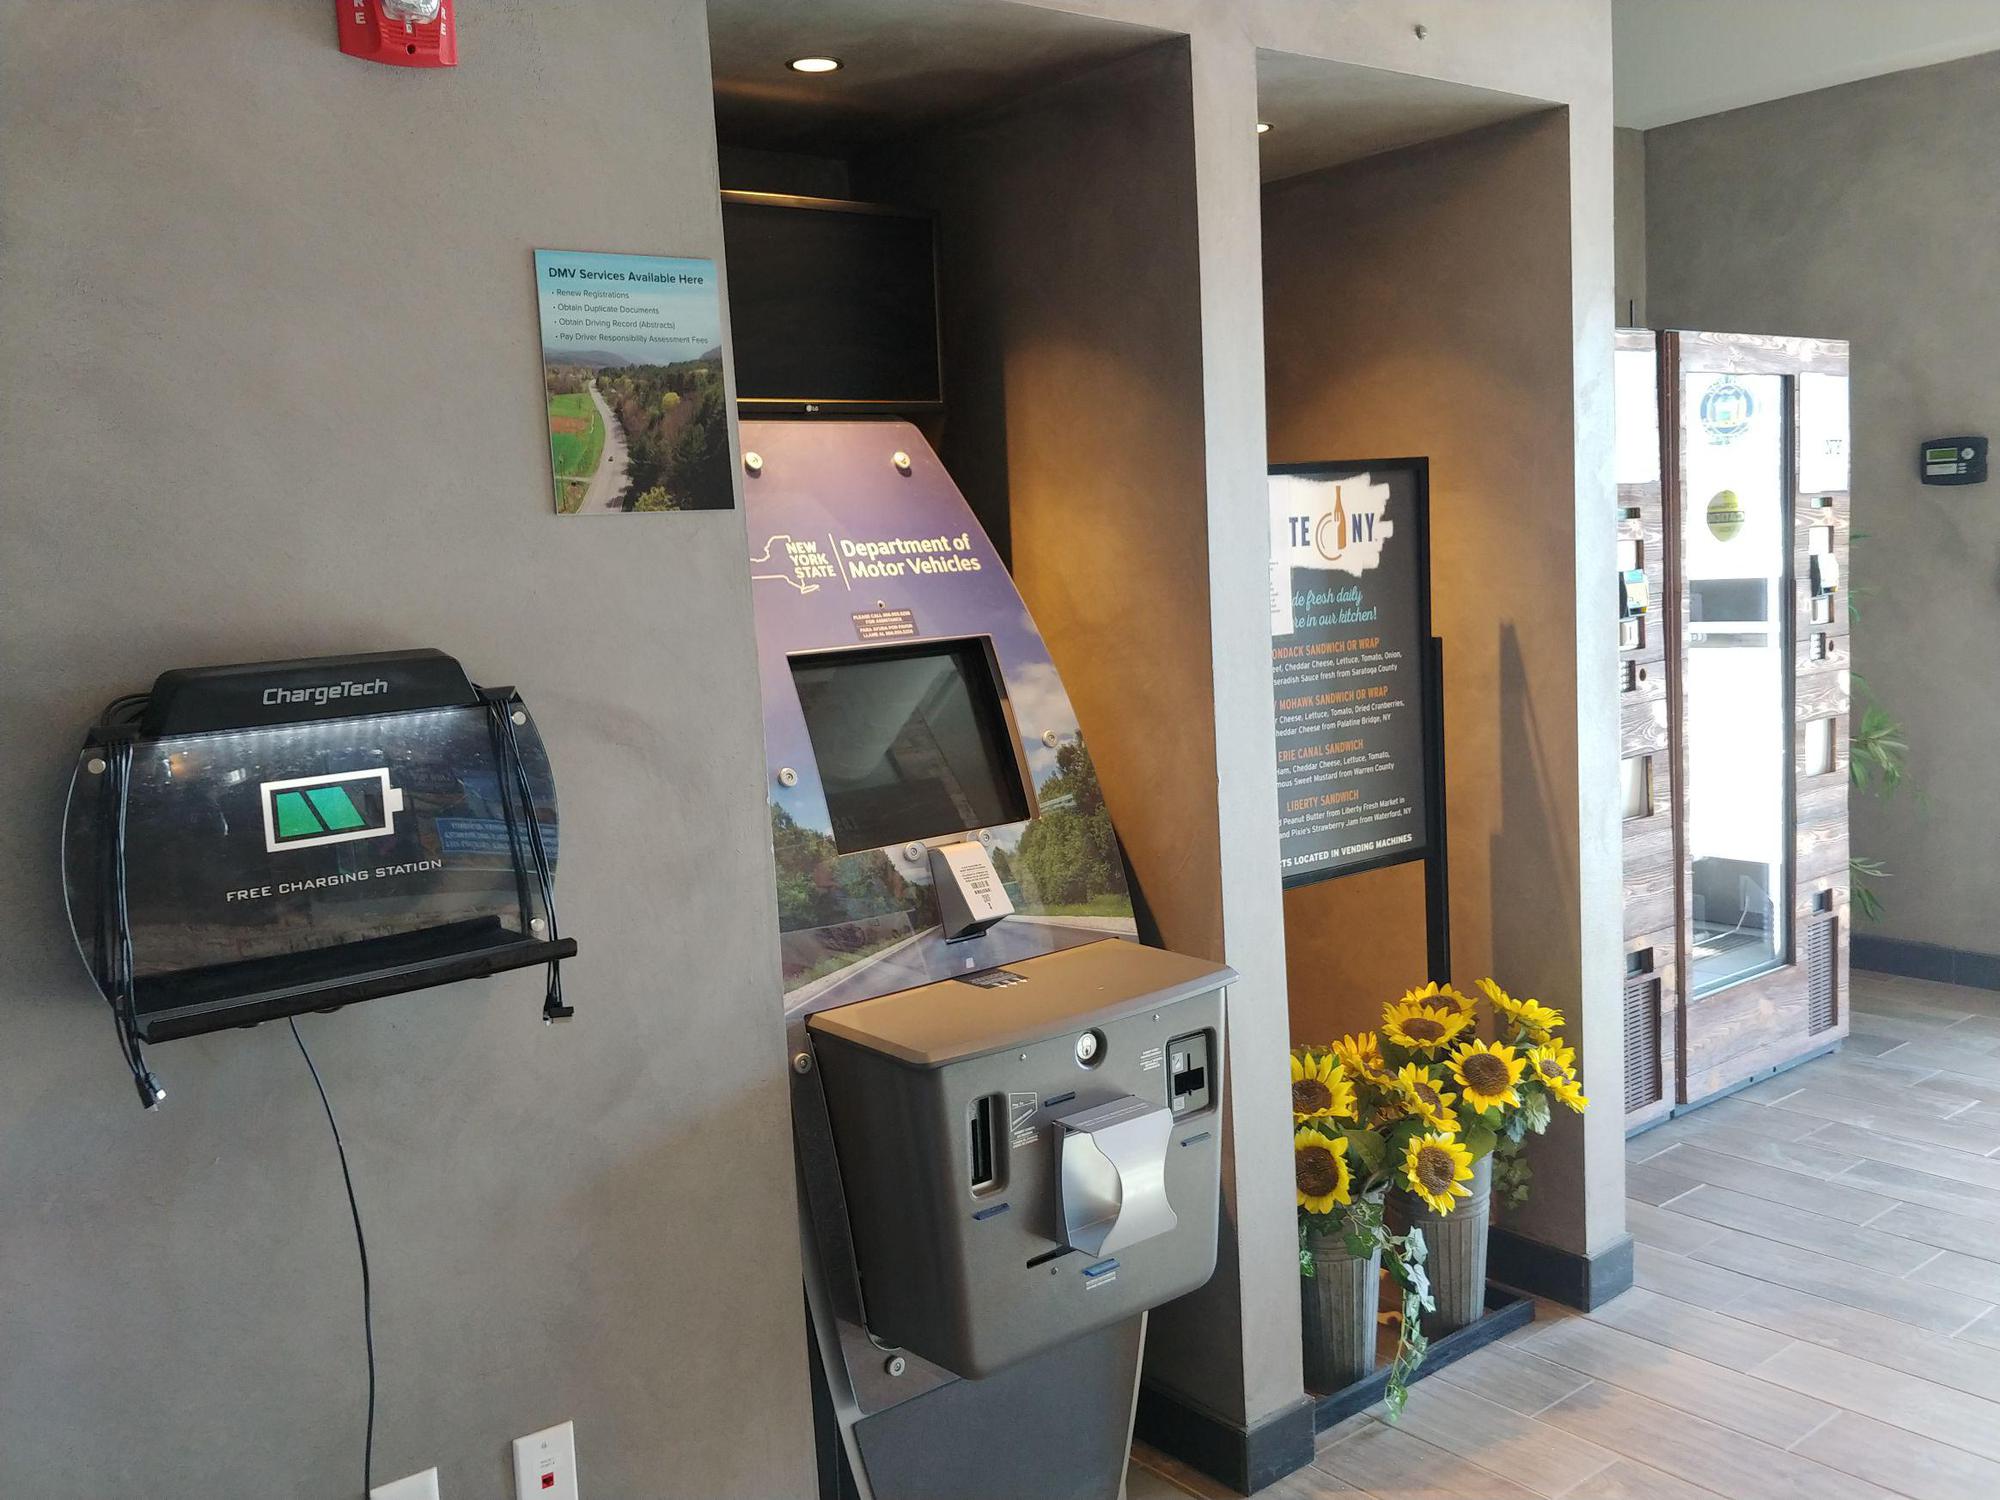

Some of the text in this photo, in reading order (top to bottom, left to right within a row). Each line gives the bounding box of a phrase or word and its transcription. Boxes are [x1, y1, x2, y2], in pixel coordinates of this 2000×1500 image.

[548, 268, 704, 284] DMV Services Available Here
[584, 290, 630, 300] Registrations
[558, 304, 660, 314] Obtain Duplicate Documents
[559, 318, 676, 330] Obtain Driving Record (Abstracts)
[560, 334, 574, 342] Pay
[599, 334, 647, 344] Responsibility
[650, 336, 690, 344] Assessment
[1352, 512, 1375, 543] NY
[786, 540, 816, 554] NEW
[840, 532, 972, 561] Department of
[790, 552, 829, 567] YORK
[848, 554, 982, 578] Motor Vehicles
[795, 566, 836, 579] STATE
[1306, 587, 1335, 611] fresh
[1306, 614, 1316, 627] in
[1318, 612, 1338, 626] our
[1338, 605, 1377, 624] kitchen!
[1306, 641, 1344, 656] SANDWICH
[1346, 640, 1356, 651] OR
[1358, 637, 1380, 650] WRAP
[1284, 662, 1310, 672] Cheddar
[1312, 659, 1334, 668] Cheese,
[1336, 656, 1360, 666] Lettuce,
[1361, 653, 1383, 662] Tomato,
[1384, 651, 1402, 660] Onion,
[1300, 674, 1319, 682] Sauce
[1320, 671, 1336, 680] fresh
[1336, 670, 1350, 678] from
[1352, 667, 1377, 676] Saratoga
[1378, 664, 1398, 672] County
[262, 678, 388, 706] ChargeTech
[1280, 696, 1313, 710] MOHAWK
[1315, 690, 1354, 706] SANDWICH
[1356, 688, 1366, 700] OR
[1368, 686, 1388, 698] WRAP
[1279, 714, 1304, 724] Cheese,
[1304, 711, 1329, 720] Lettuce,
[1330, 707, 1354, 716] Tomato,
[1354, 704, 1370, 713] Dried
[1371, 700, 1405, 710] Cranberries,
[1298, 725, 1320, 734] Cheese
[1322, 722, 1336, 730] from
[1336, 718, 1360, 728] Palatine
[1362, 716, 1382, 724] Bridge,
[1382, 713, 1392, 721] NY
[1278, 740, 1364, 762] ERIE CANAL SANDWICH
[1292, 763, 1318, 773] Cheddar
[1319, 760, 1342, 768] Cheese,
[1344, 756, 1366, 765] Lettuce,
[1368, 751, 1390, 760] Tomato,
[1294, 776, 1312, 786] Sweet
[1314, 771, 1338, 782] Mustard
[1338, 770, 1353, 778] from
[1354, 766, 1374, 775] Warren
[1374, 762, 1394, 772] County
[1287, 789, 1360, 812] LIBERTY SANDWICH
[1283, 816, 1304, 826] Peanut
[1306, 812, 1325, 822] Butter
[1341, 806, 1362, 815] Liberty
[1363, 802, 1378, 810] Fresh
[1380, 798, 1398, 808] Market
[1312, 821, 1344, 832] Strawberry
[1346, 818, 1358, 826] Jam
[1360, 816, 1373, 824] from
[1374, 809, 1402, 820] Waterford,
[1294, 850, 1329, 865] LOCATED
[1330, 848, 1339, 858] IN
[1340, 842, 1374, 856] VENDING
[1376, 834, 1412, 848] MACHINES
[226, 859, 442, 902] FREE CHARGING STATION
